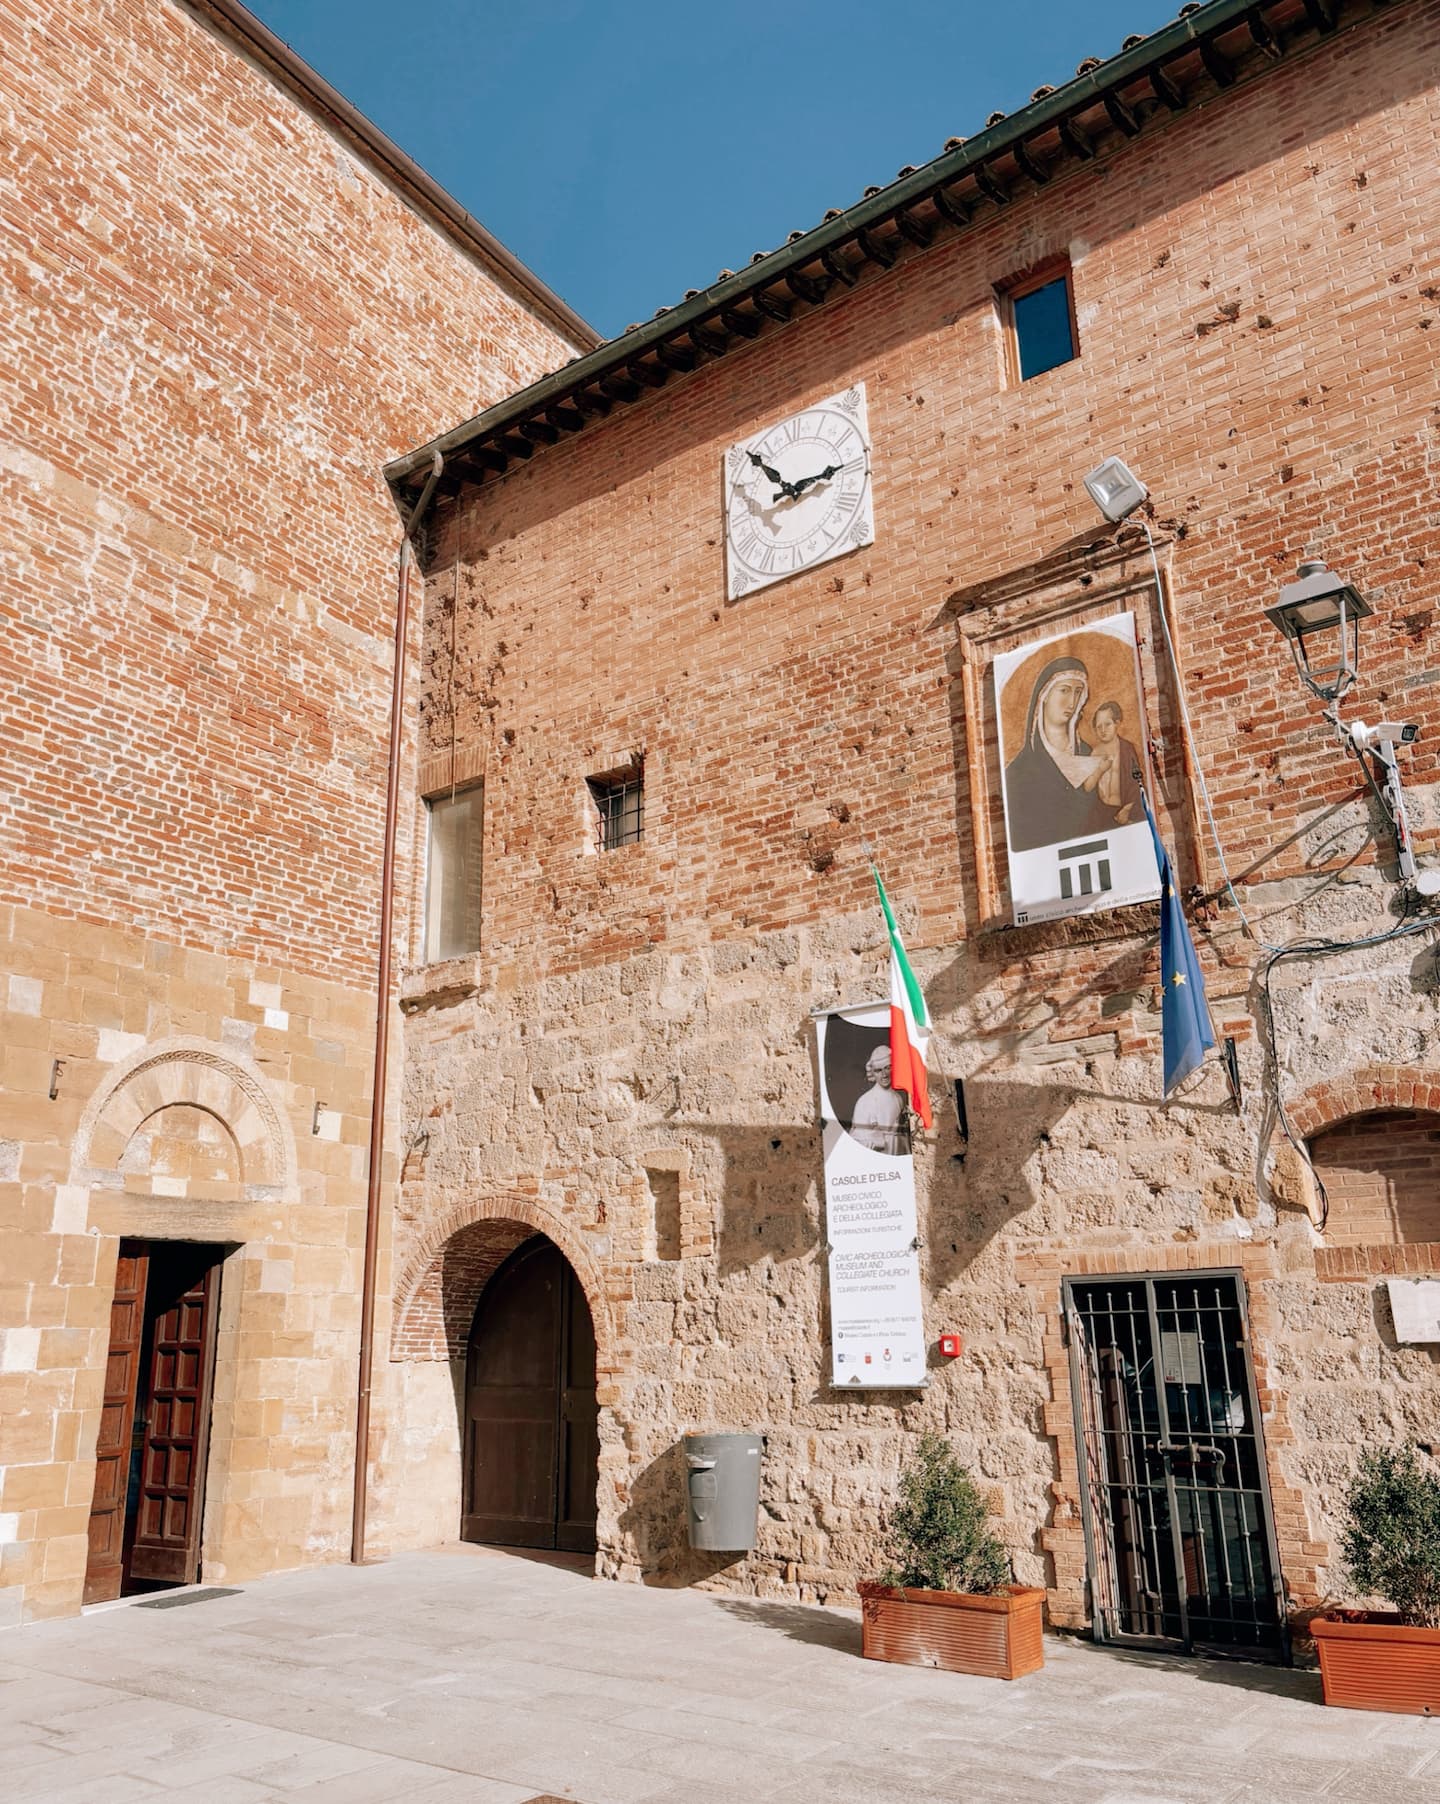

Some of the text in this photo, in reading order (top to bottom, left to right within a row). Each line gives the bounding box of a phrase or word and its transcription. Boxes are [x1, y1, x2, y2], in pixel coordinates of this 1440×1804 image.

[831, 1171, 902, 1186] CASOLE D'ELSA
[832, 1190, 882, 1203] MUSEO CIVICO
[833, 1200, 889, 1212] ARCHEOLOGICO
[839, 1213, 861, 1222] DELLA
[861, 1209, 903, 1220] COLLEGIATA
[835, 1249, 911, 1262] CIVIC ARCHEOLOGICAL
[836, 1260, 884, 1271] MUSEUM AND
[836, 1267, 910, 1280] COLLEGIATE CHURCH
